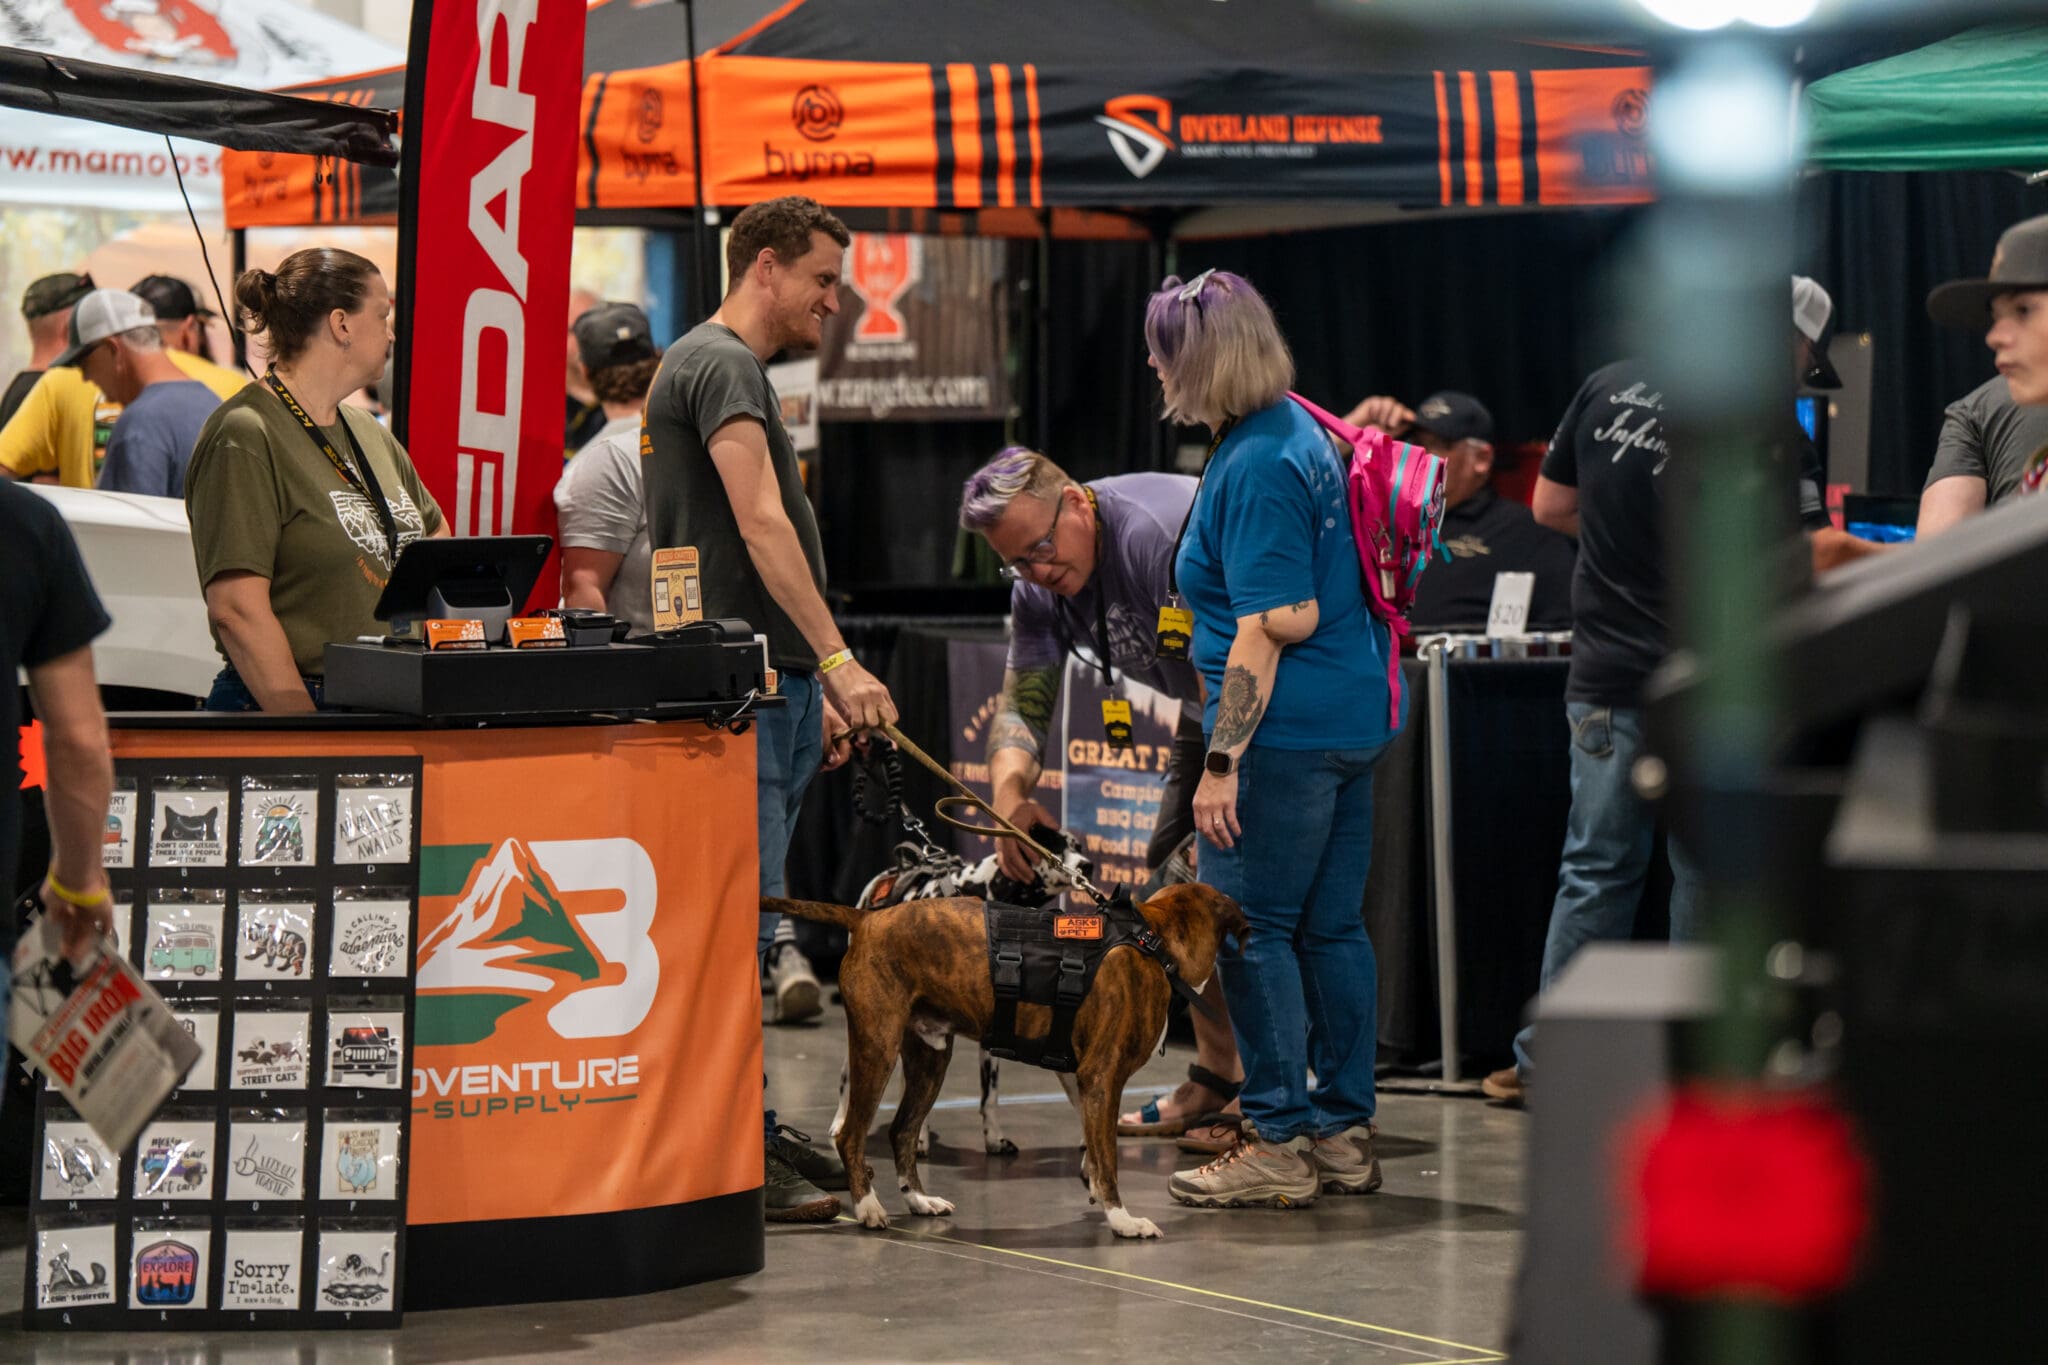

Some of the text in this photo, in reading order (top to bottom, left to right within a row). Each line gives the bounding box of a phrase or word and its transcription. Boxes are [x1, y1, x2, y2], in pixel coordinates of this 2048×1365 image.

[1180, 114, 1383, 143] OVERLAND DEFENSE
[0, 146, 223, 177] w.mamoos
[764, 141, 876, 181] byrna
[1068, 739, 1151, 770] GREAT
[1101, 781, 1165, 805] Campin
[366, 865, 375, 873] D
[1101, 863, 1132, 883] Fire
[351, 913, 390, 928] CALLING
[47, 1028, 91, 1088] BIG
[241, 1072, 297, 1085] STREET CATS
[412, 1055, 640, 1098] DVENTURE
[356, 1089, 365, 1100] L
[433, 1094, 581, 1119] SUPPLY
[143, 1261, 191, 1273] EXPLORE
[233, 1259, 290, 1281] Sorry
[227, 1280, 295, 1294] I'm late.
